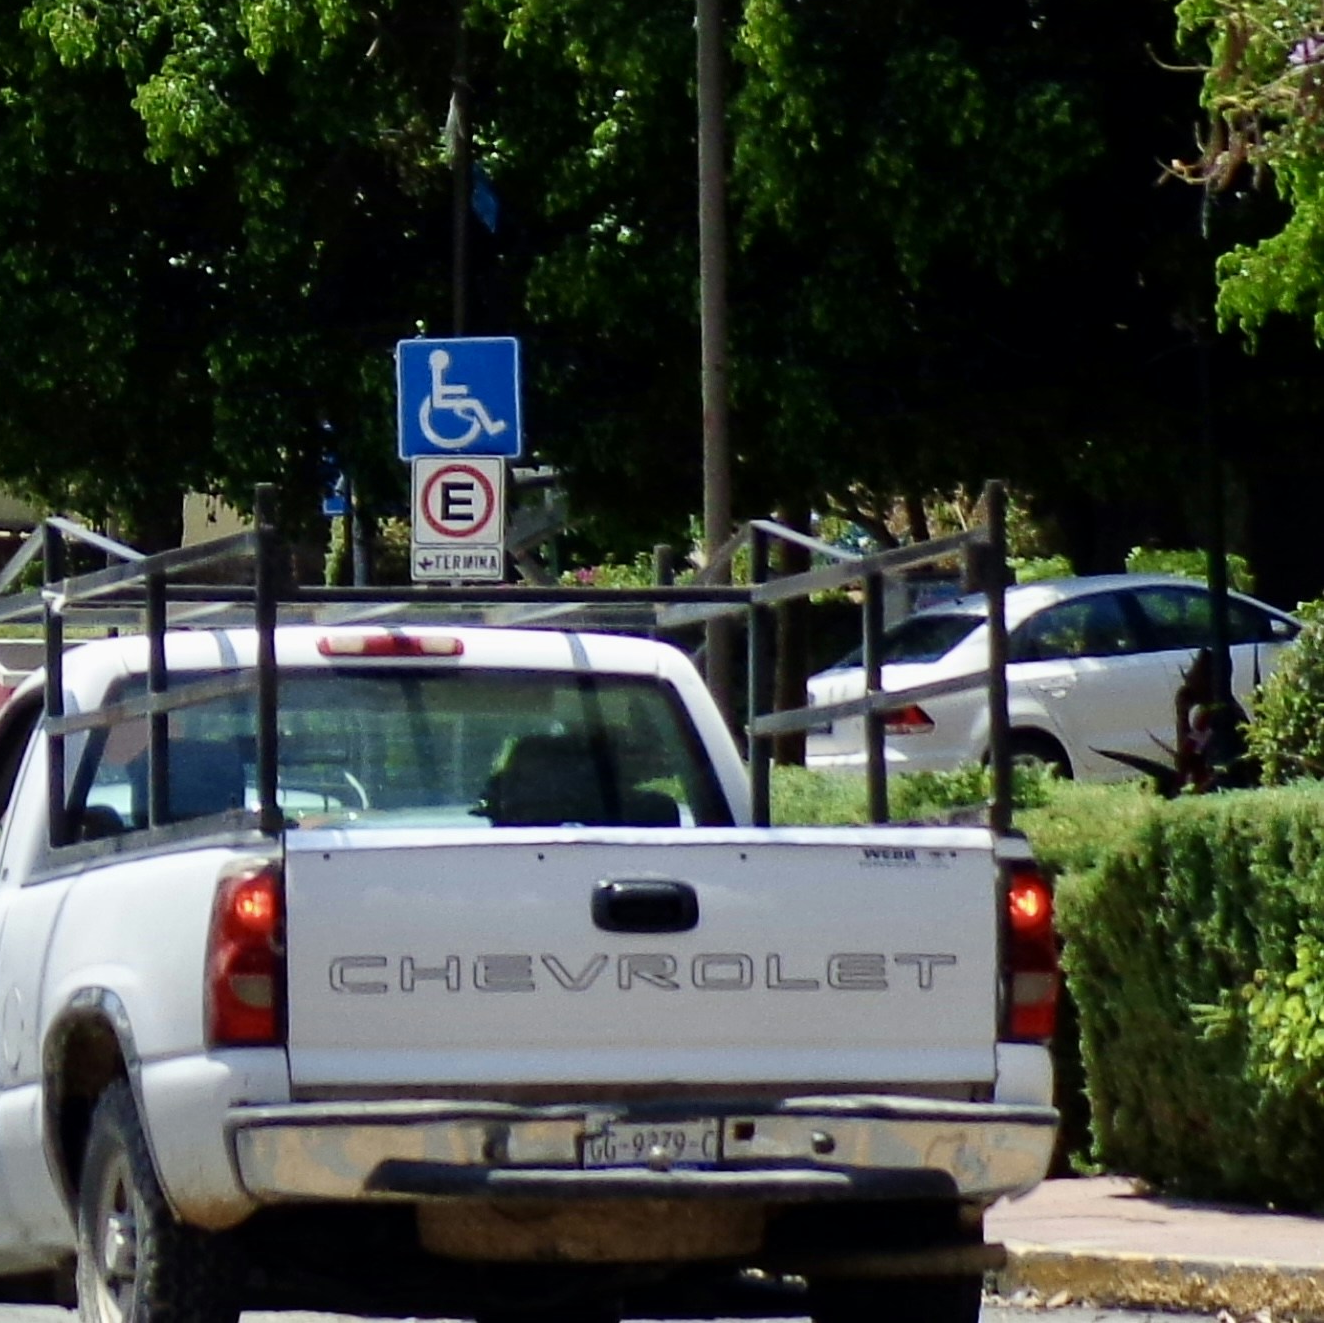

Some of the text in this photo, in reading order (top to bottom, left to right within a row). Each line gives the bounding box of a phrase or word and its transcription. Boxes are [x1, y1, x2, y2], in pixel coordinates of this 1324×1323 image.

[441, 481, 474, 521] E
[435, 555, 498, 569] TERMINA
[328, 953, 957, 994] CHEVROLET
